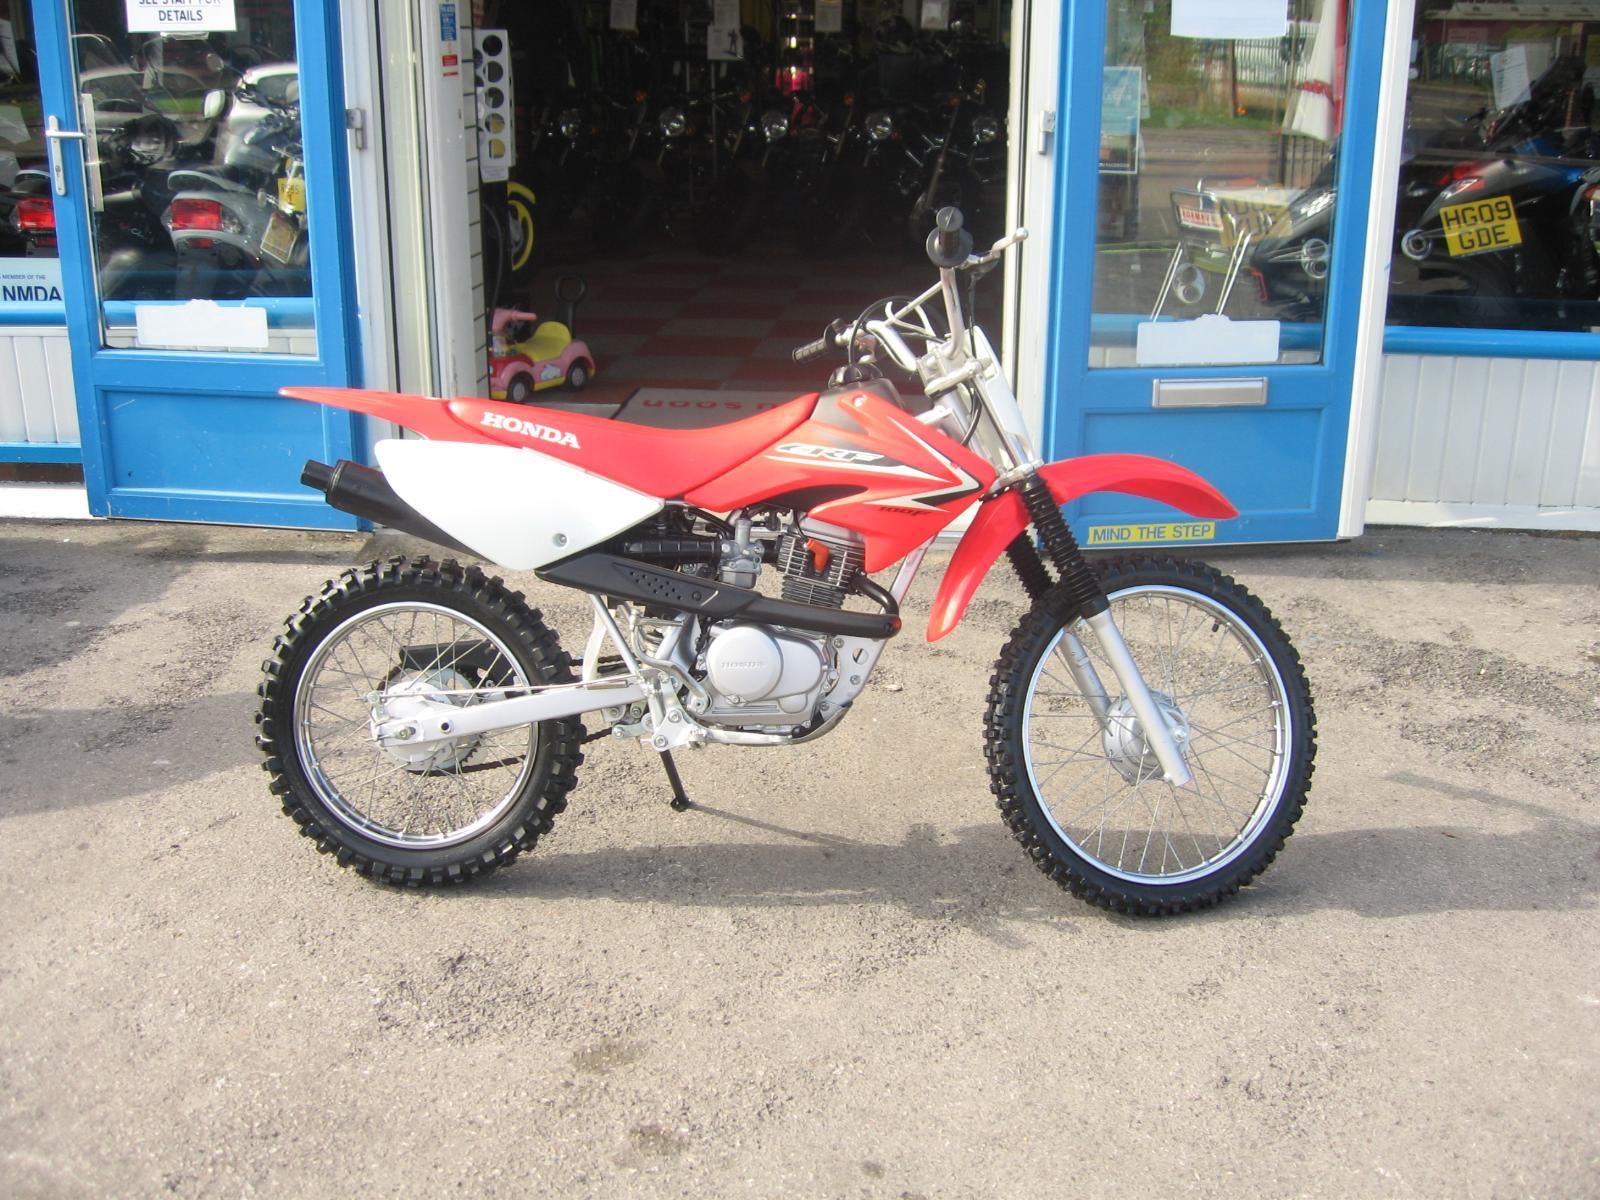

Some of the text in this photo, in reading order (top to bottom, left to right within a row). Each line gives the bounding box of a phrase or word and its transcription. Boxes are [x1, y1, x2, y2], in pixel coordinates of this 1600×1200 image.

[159, 9, 203, 21] DETAILS
[1443, 201, 1512, 230] HG09
[1458, 224, 1509, 249] GDE
[2, 285, 63, 301] NMDA
[480, 411, 580, 449] HONDA
[1093, 524, 1211, 541] MIND THE STEP
